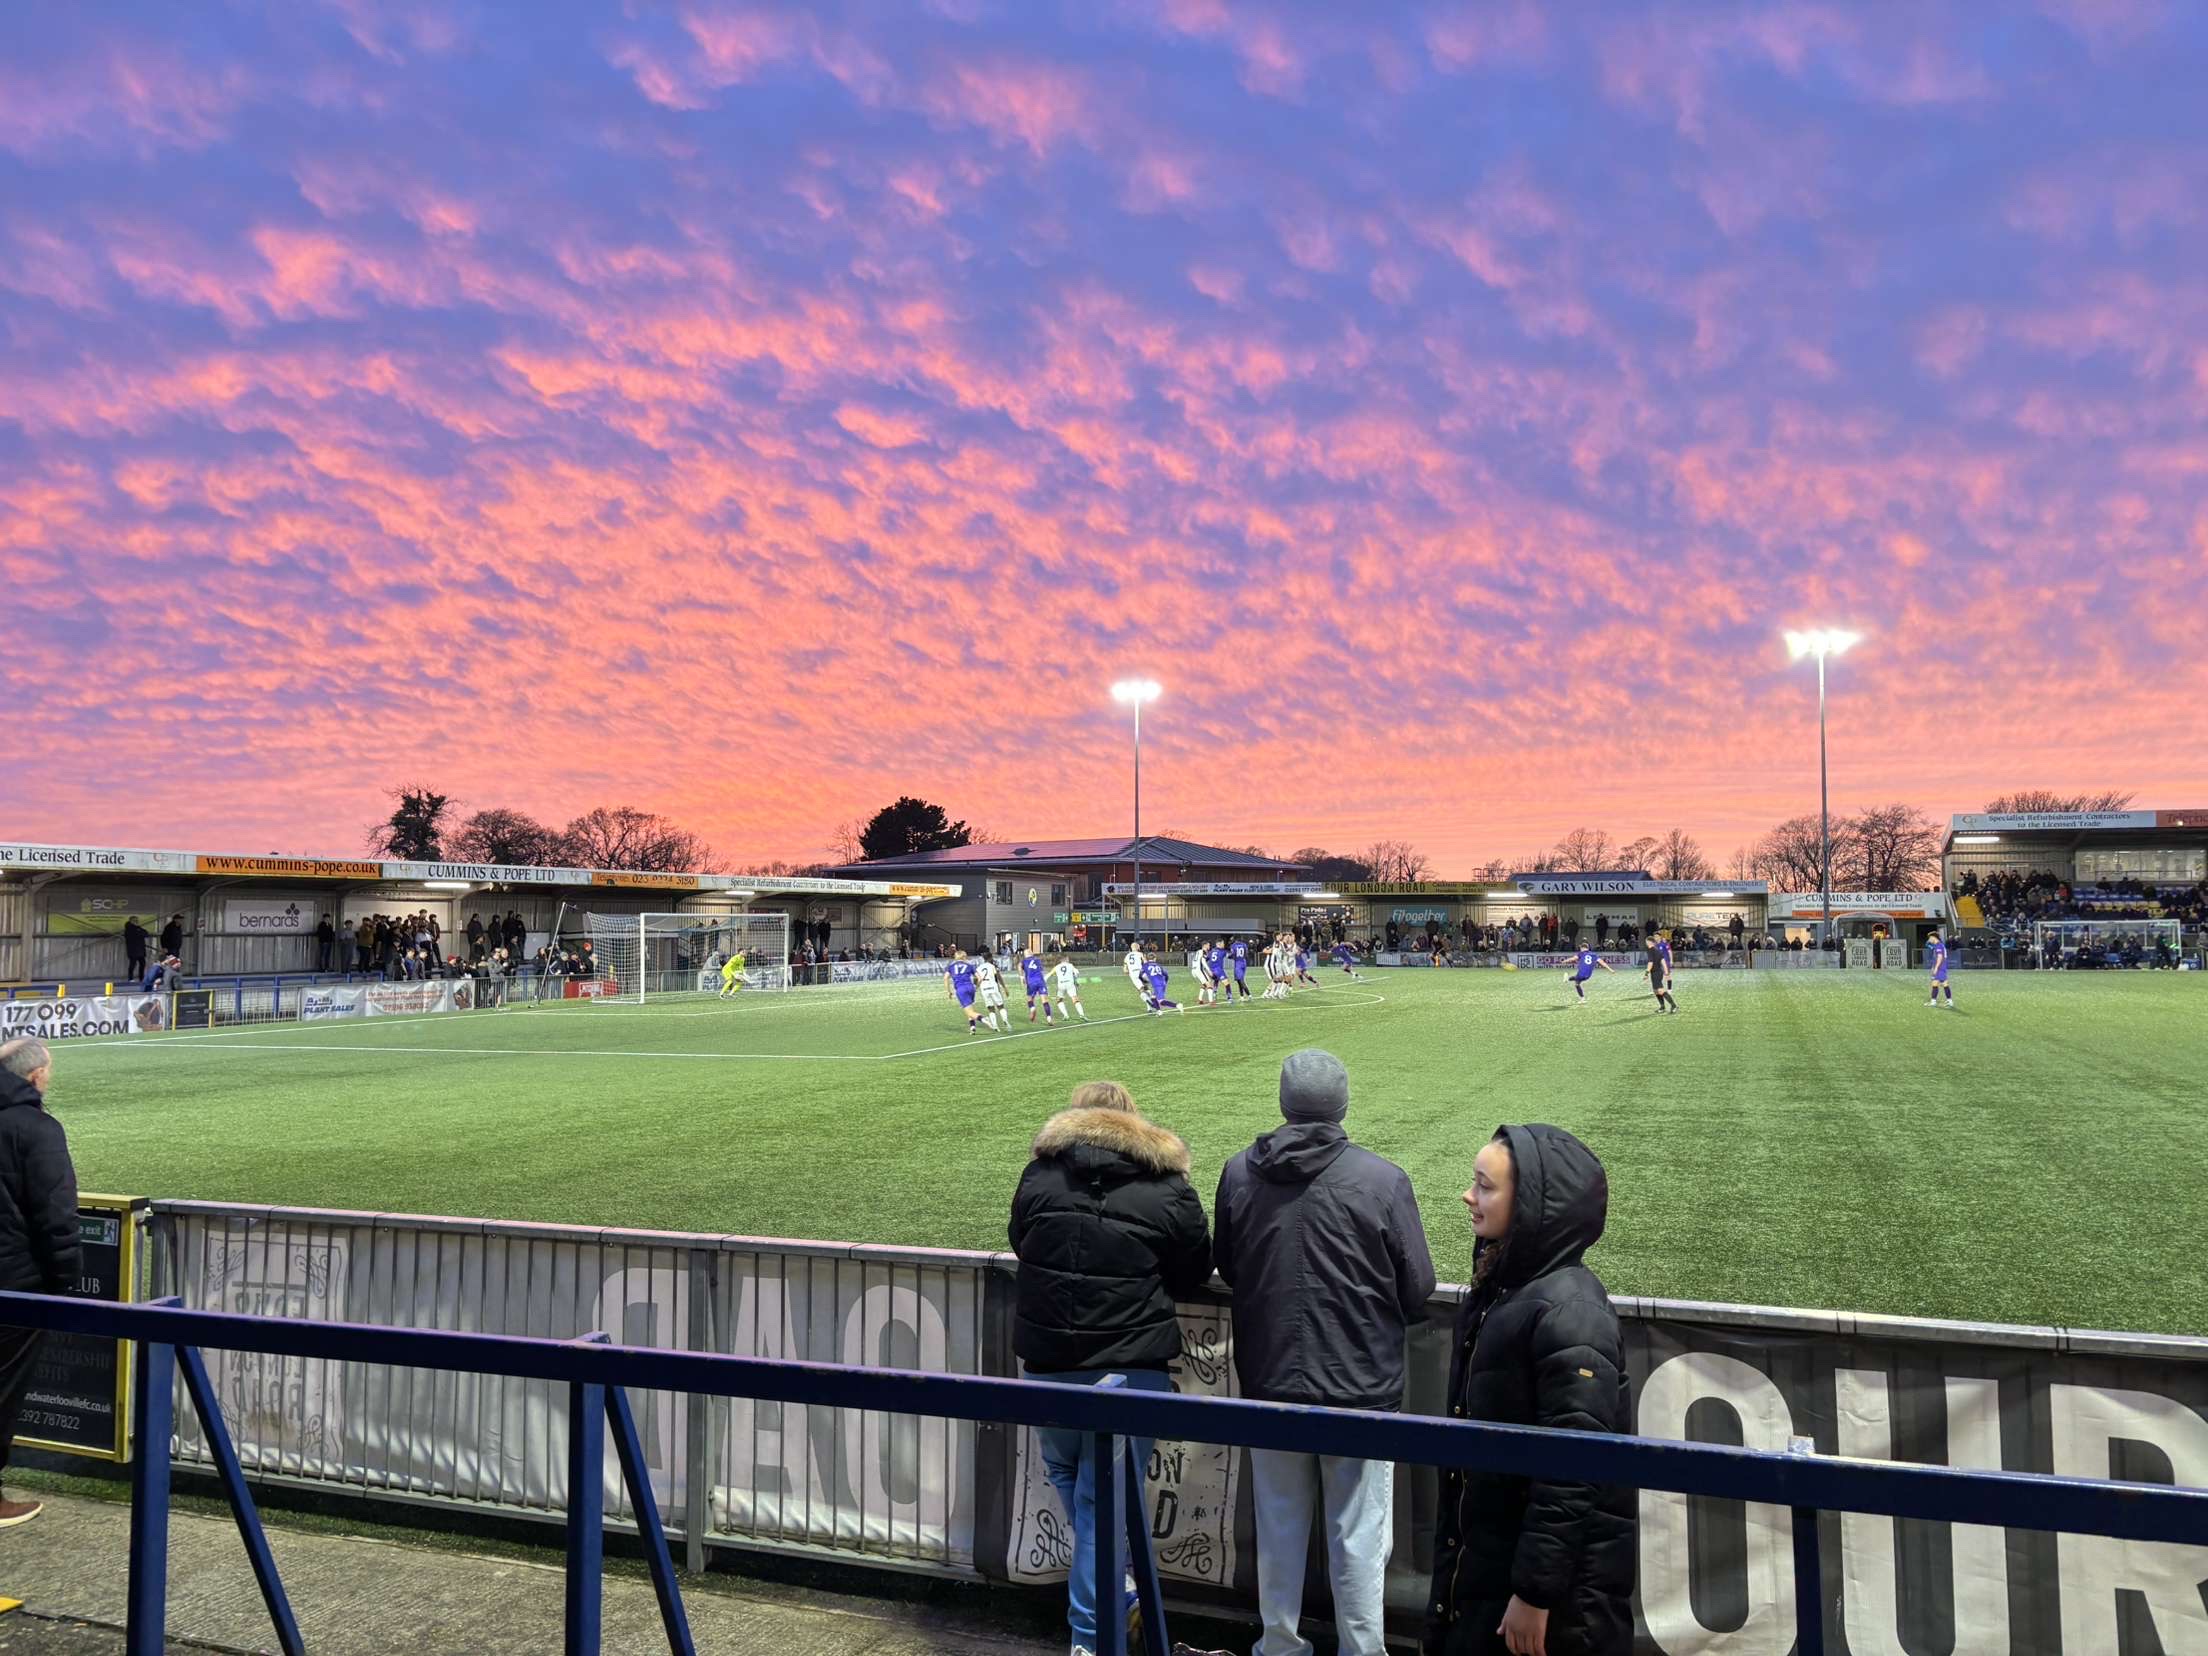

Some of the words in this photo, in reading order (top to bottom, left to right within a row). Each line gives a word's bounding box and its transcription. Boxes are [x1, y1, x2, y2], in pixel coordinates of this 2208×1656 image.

[1988, 814, 2025, 822] Specialist
[2027, 813, 2082, 821] Refurbishment
[2085, 812, 2131, 820] Contractors
[19, 848, 81, 863] Licensed
[86, 851, 125, 865] Trade
[206, 857, 377, 875] www.cummins-pope.co.uk
[428, 864, 486, 879] CUMMINS
[490, 868, 500, 880] &
[504, 868, 531, 881] POPE
[536, 870, 555, 882] LTD
[1324, 883, 1350, 893] FOUR
[1354, 883, 1394, 894] LONDON
[1400, 882, 1426, 893] ROAD
[1541, 882, 1578, 892] GARY
[1578, 882, 1635, 892] WILSON
[1805, 894, 1852, 902] CUMMINS
[1856, 894, 1863, 902] &
[1867, 894, 1891, 902] POPE
[1894, 894, 1913, 902] LTD
[239, 912, 300, 928] bernards
[1212, 951, 1218, 961] 5
[1236, 947, 1245, 957] 10
[1028, 960, 1037, 969] 4
[1129, 954, 1135, 965] 5
[1584, 955, 1592, 964] 8
[954, 964, 968, 974] 17
[981, 968, 989, 981] 2
[1060, 965, 1067, 976] 9
[6, 1003, 33, 1023] 177
[303, 1005, 329, 1014] PLANT
[330, 1004, 355, 1012] SALES
[2, 1019, 129, 1042] NTSALES.COM
[18, 1408, 41, 1425] 392
